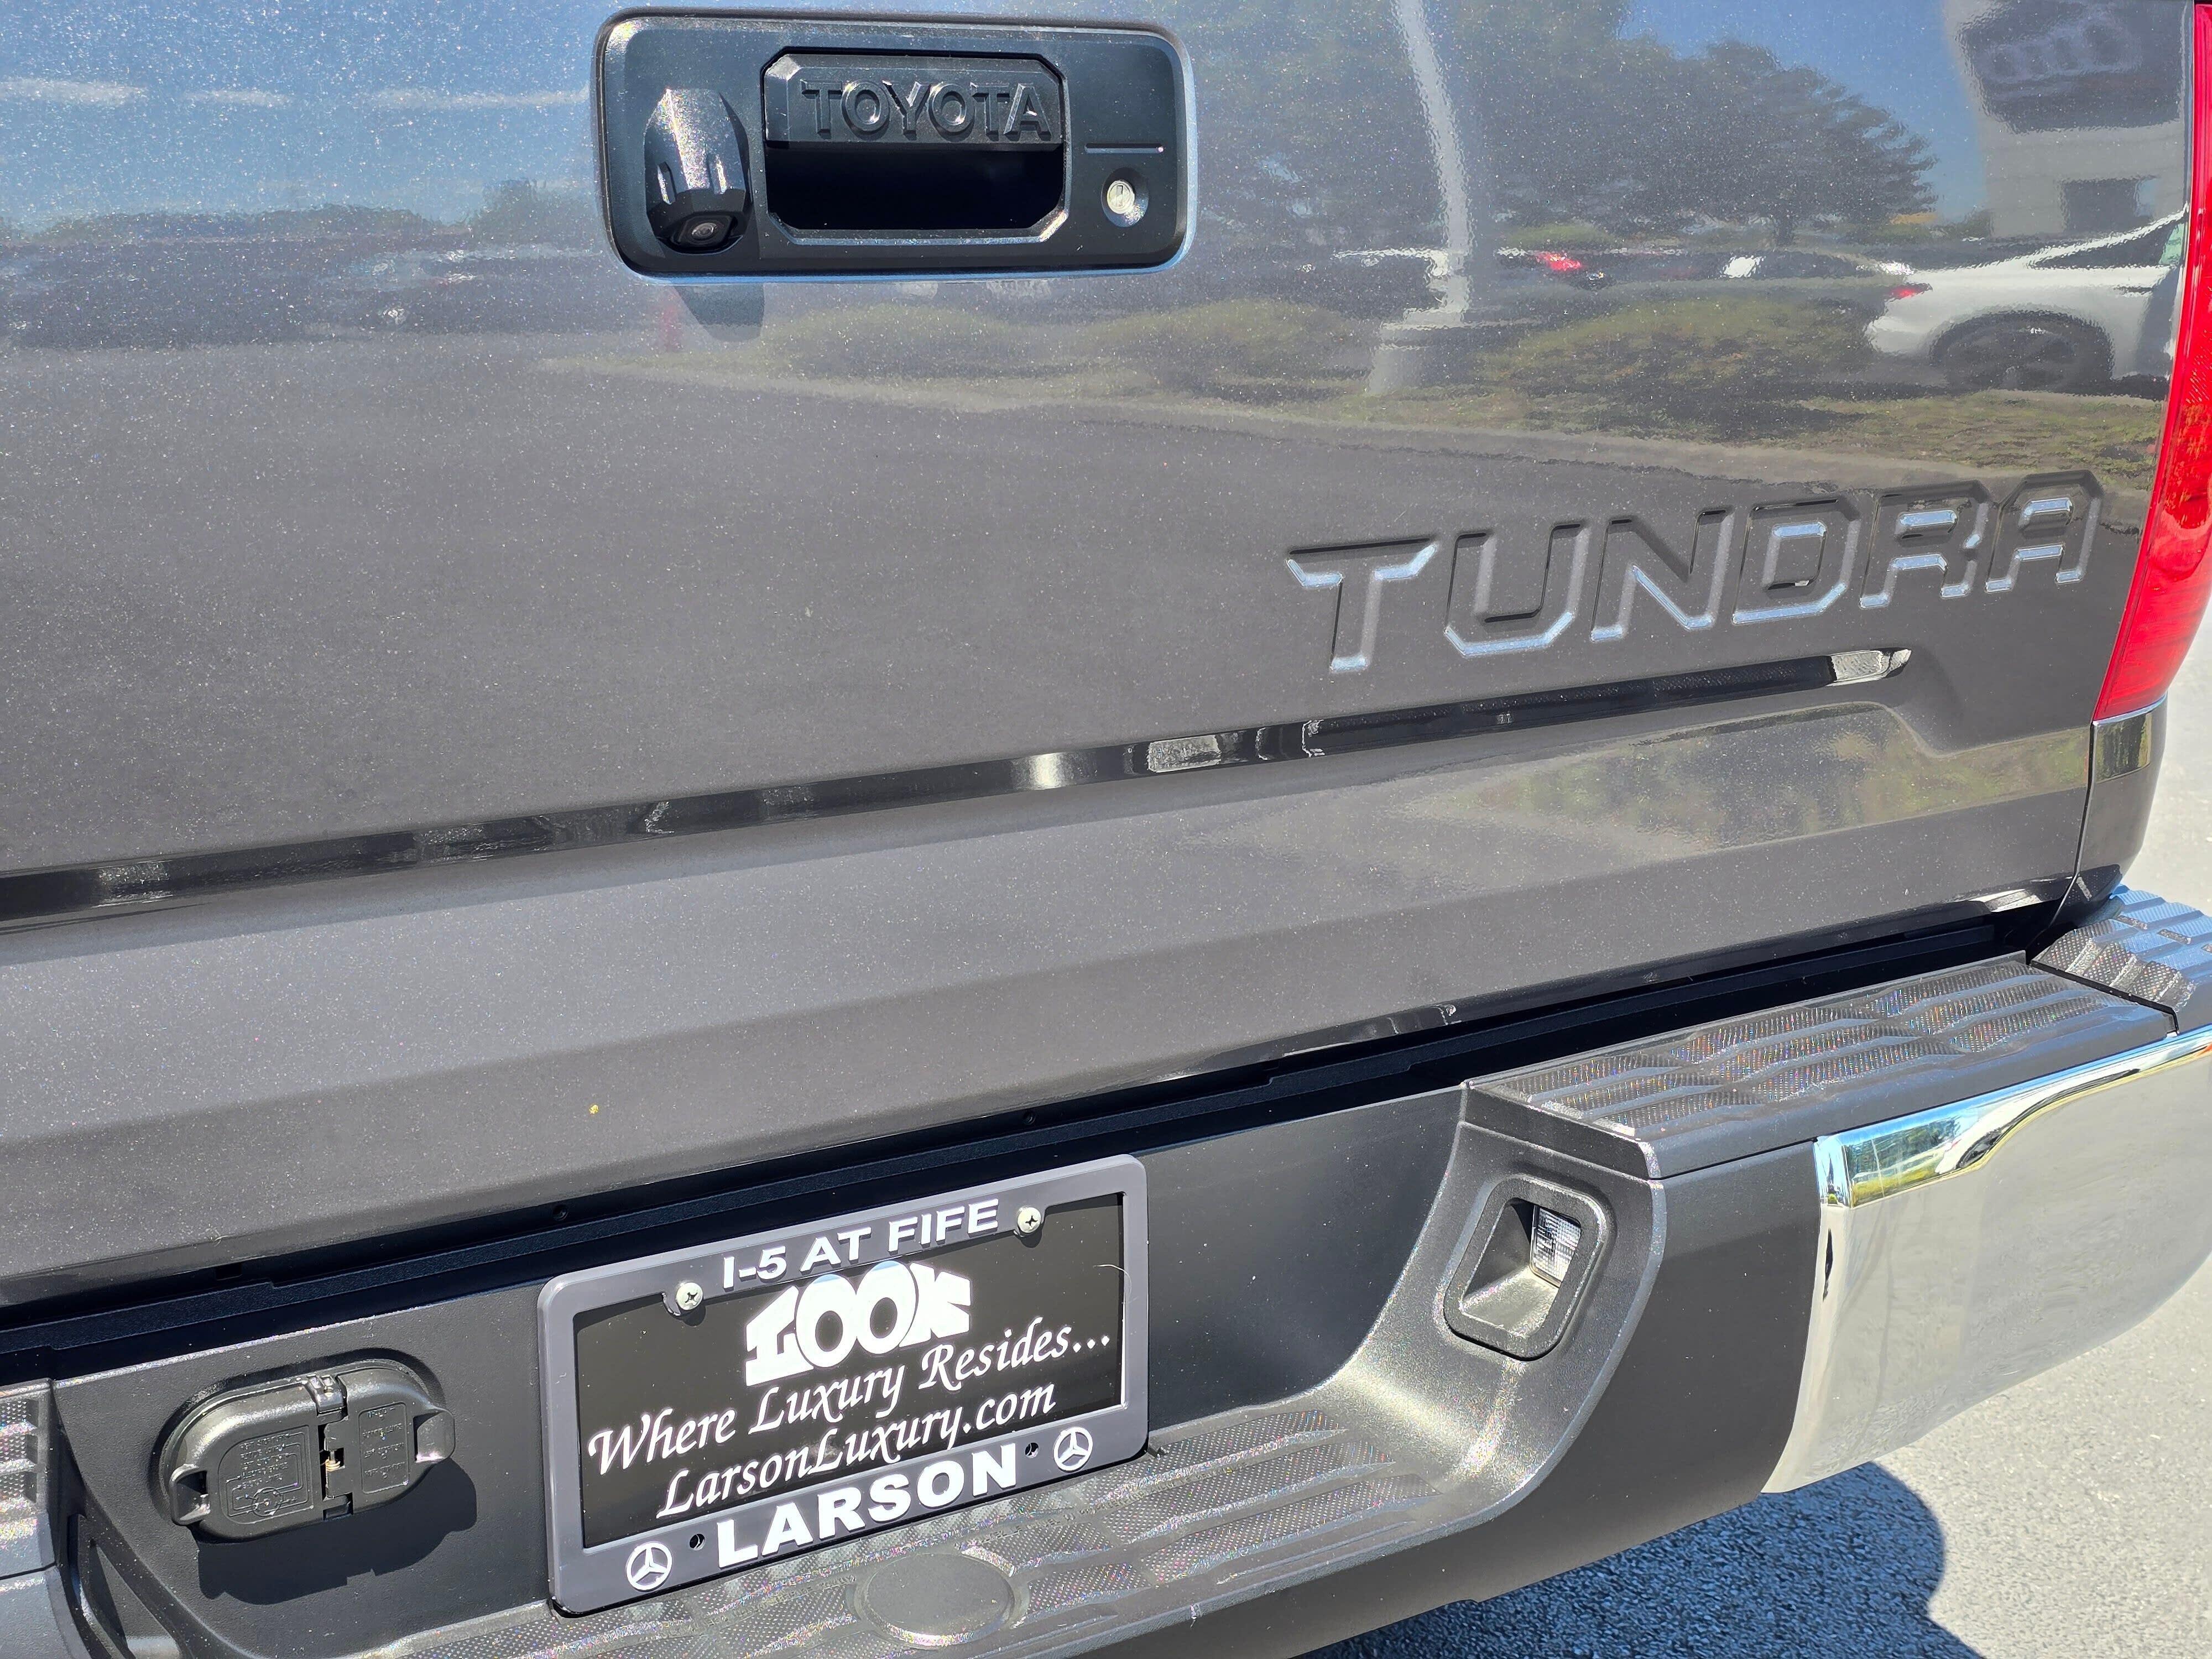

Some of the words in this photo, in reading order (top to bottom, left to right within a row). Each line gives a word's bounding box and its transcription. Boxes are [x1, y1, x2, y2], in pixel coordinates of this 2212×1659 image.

[799, 79, 1053, 142] TOYOTA
[1286, 469, 2104, 673] TUNDRA
[722, 1245, 787, 1290] I-5
[799, 1227, 872, 1272] AT
[887, 1198, 999, 1253] FIFE
[746, 1260, 971, 1386] LOOK
[588, 1407, 737, 1475] Where
[748, 1365, 906, 1435] Luxury
[918, 1317, 1110, 1391] Resides...
[656, 1384, 1057, 1519] LarsonLuxury.com
[716, 1443, 1016, 1568] LARSON
